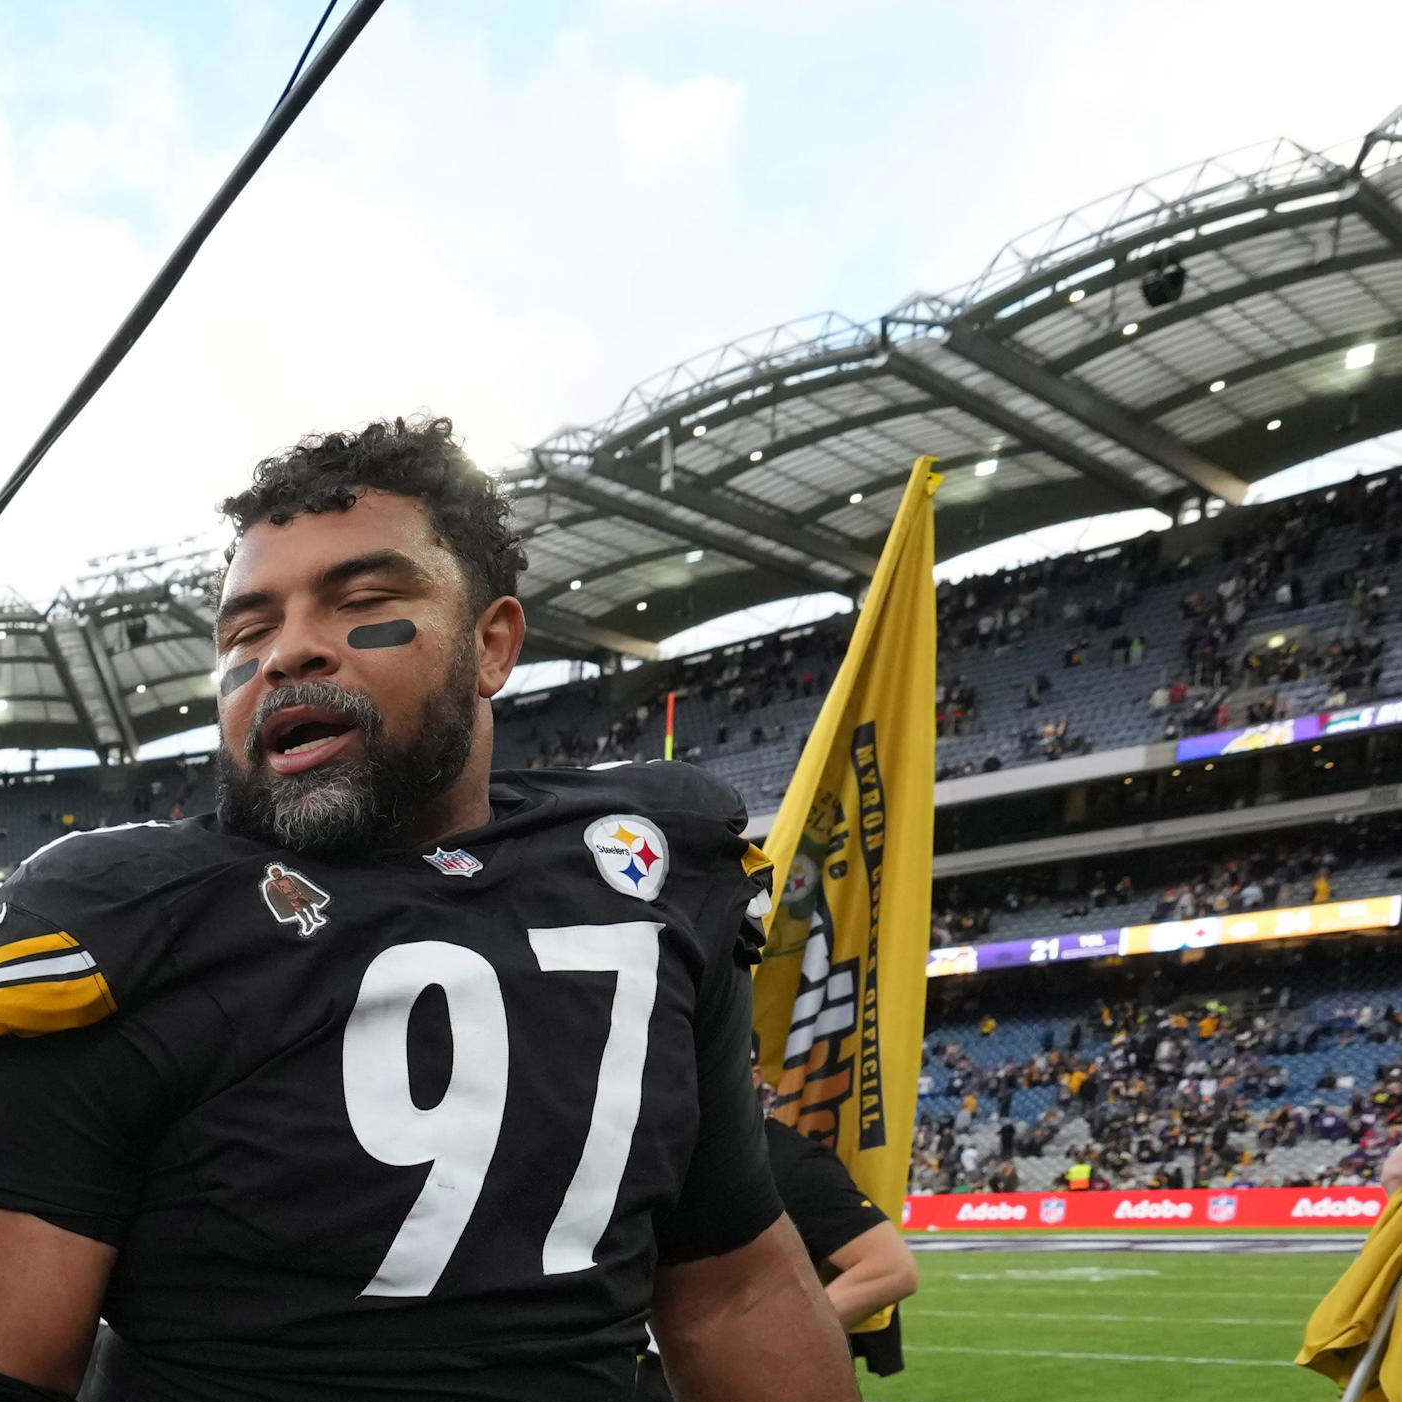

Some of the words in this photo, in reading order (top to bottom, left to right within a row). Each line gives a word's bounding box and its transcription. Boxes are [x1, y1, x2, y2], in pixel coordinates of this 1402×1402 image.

[856, 744, 884, 851] MYRON
[440, 858, 475, 870] NFL
[1029, 938, 1059, 961] 21
[861, 988, 881, 1129] OFFICIAL
[342, 921, 666, 1300] 97
[956, 1202, 1028, 1221] Adobe
[1113, 1199, 1193, 1219] Adobe
[1290, 1196, 1381, 1217] Adobe
